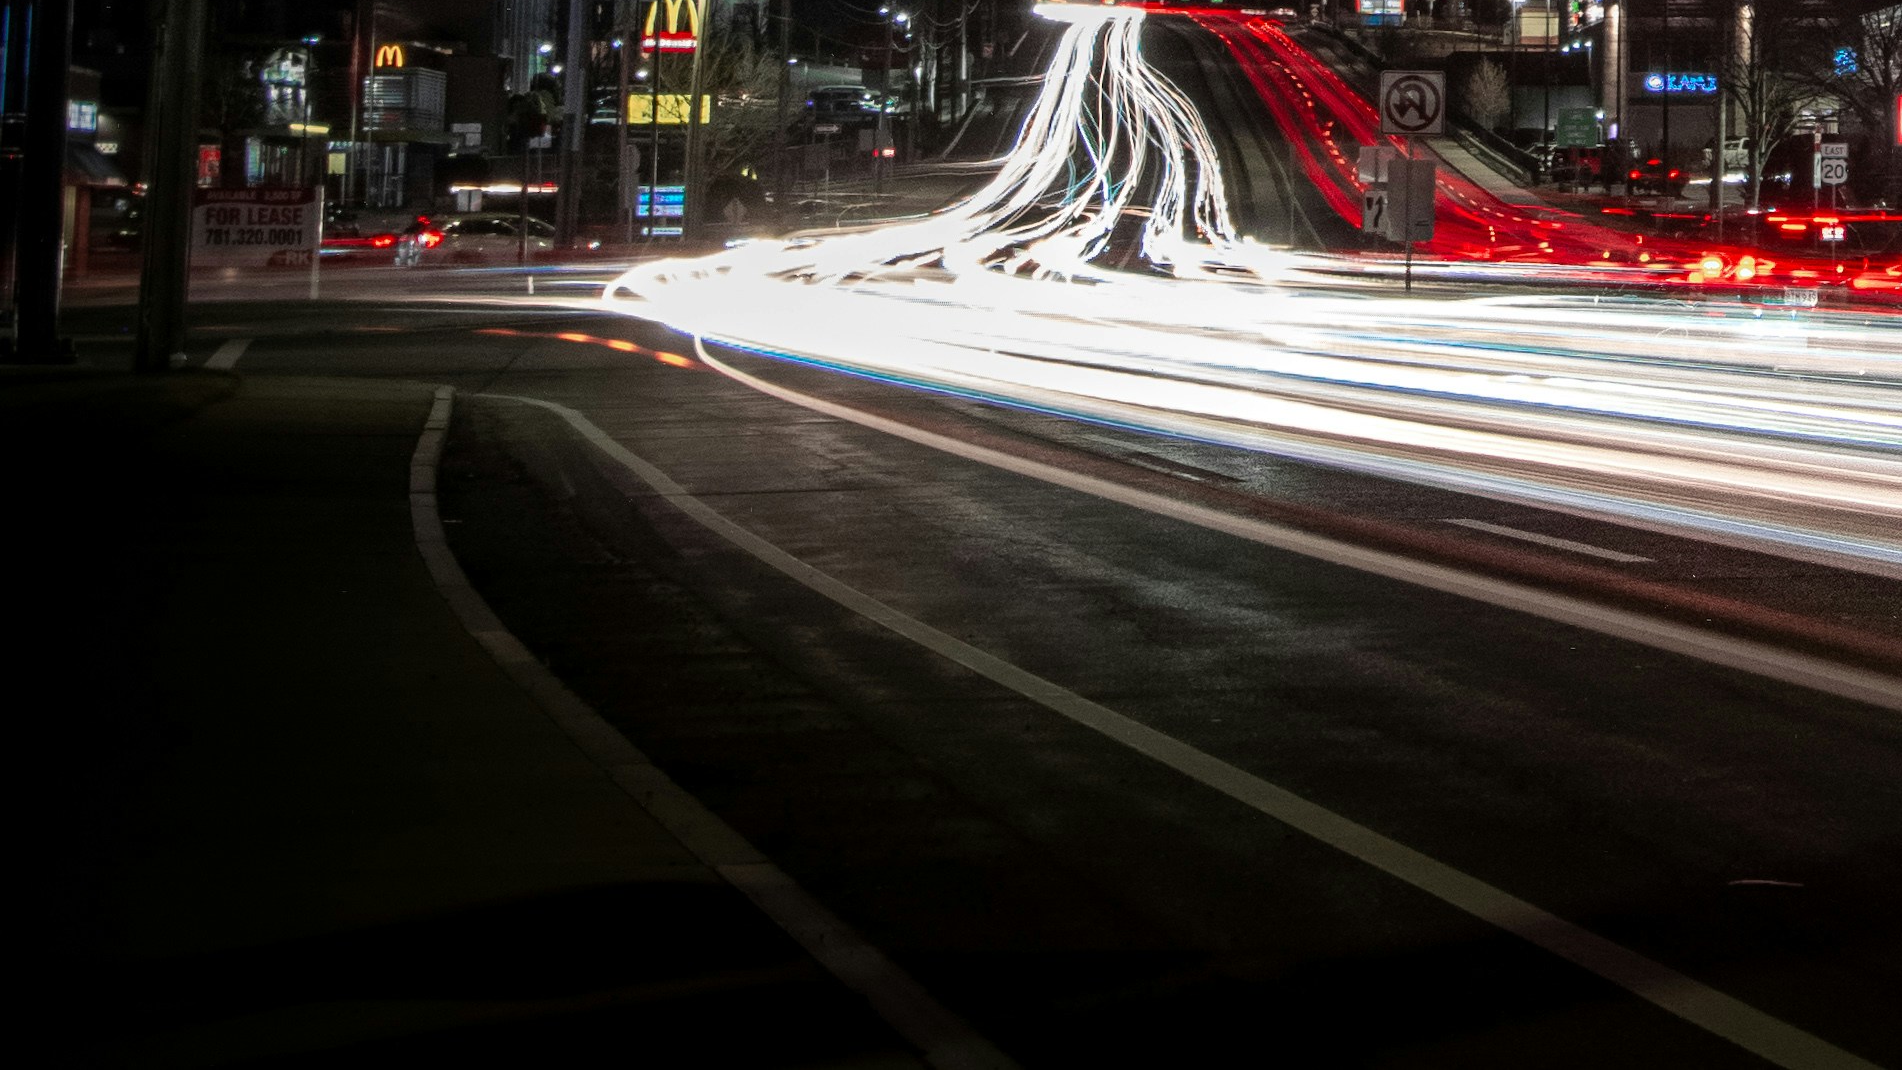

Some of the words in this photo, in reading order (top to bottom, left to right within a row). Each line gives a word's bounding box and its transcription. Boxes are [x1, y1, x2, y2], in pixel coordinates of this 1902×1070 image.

[1825, 146, 1844, 155] EAST
[1824, 164, 1844, 179] 20
[206, 208, 240, 225] FOR
[247, 208, 303, 226] LEASE
[206, 228, 303, 246] 781.320.0001
